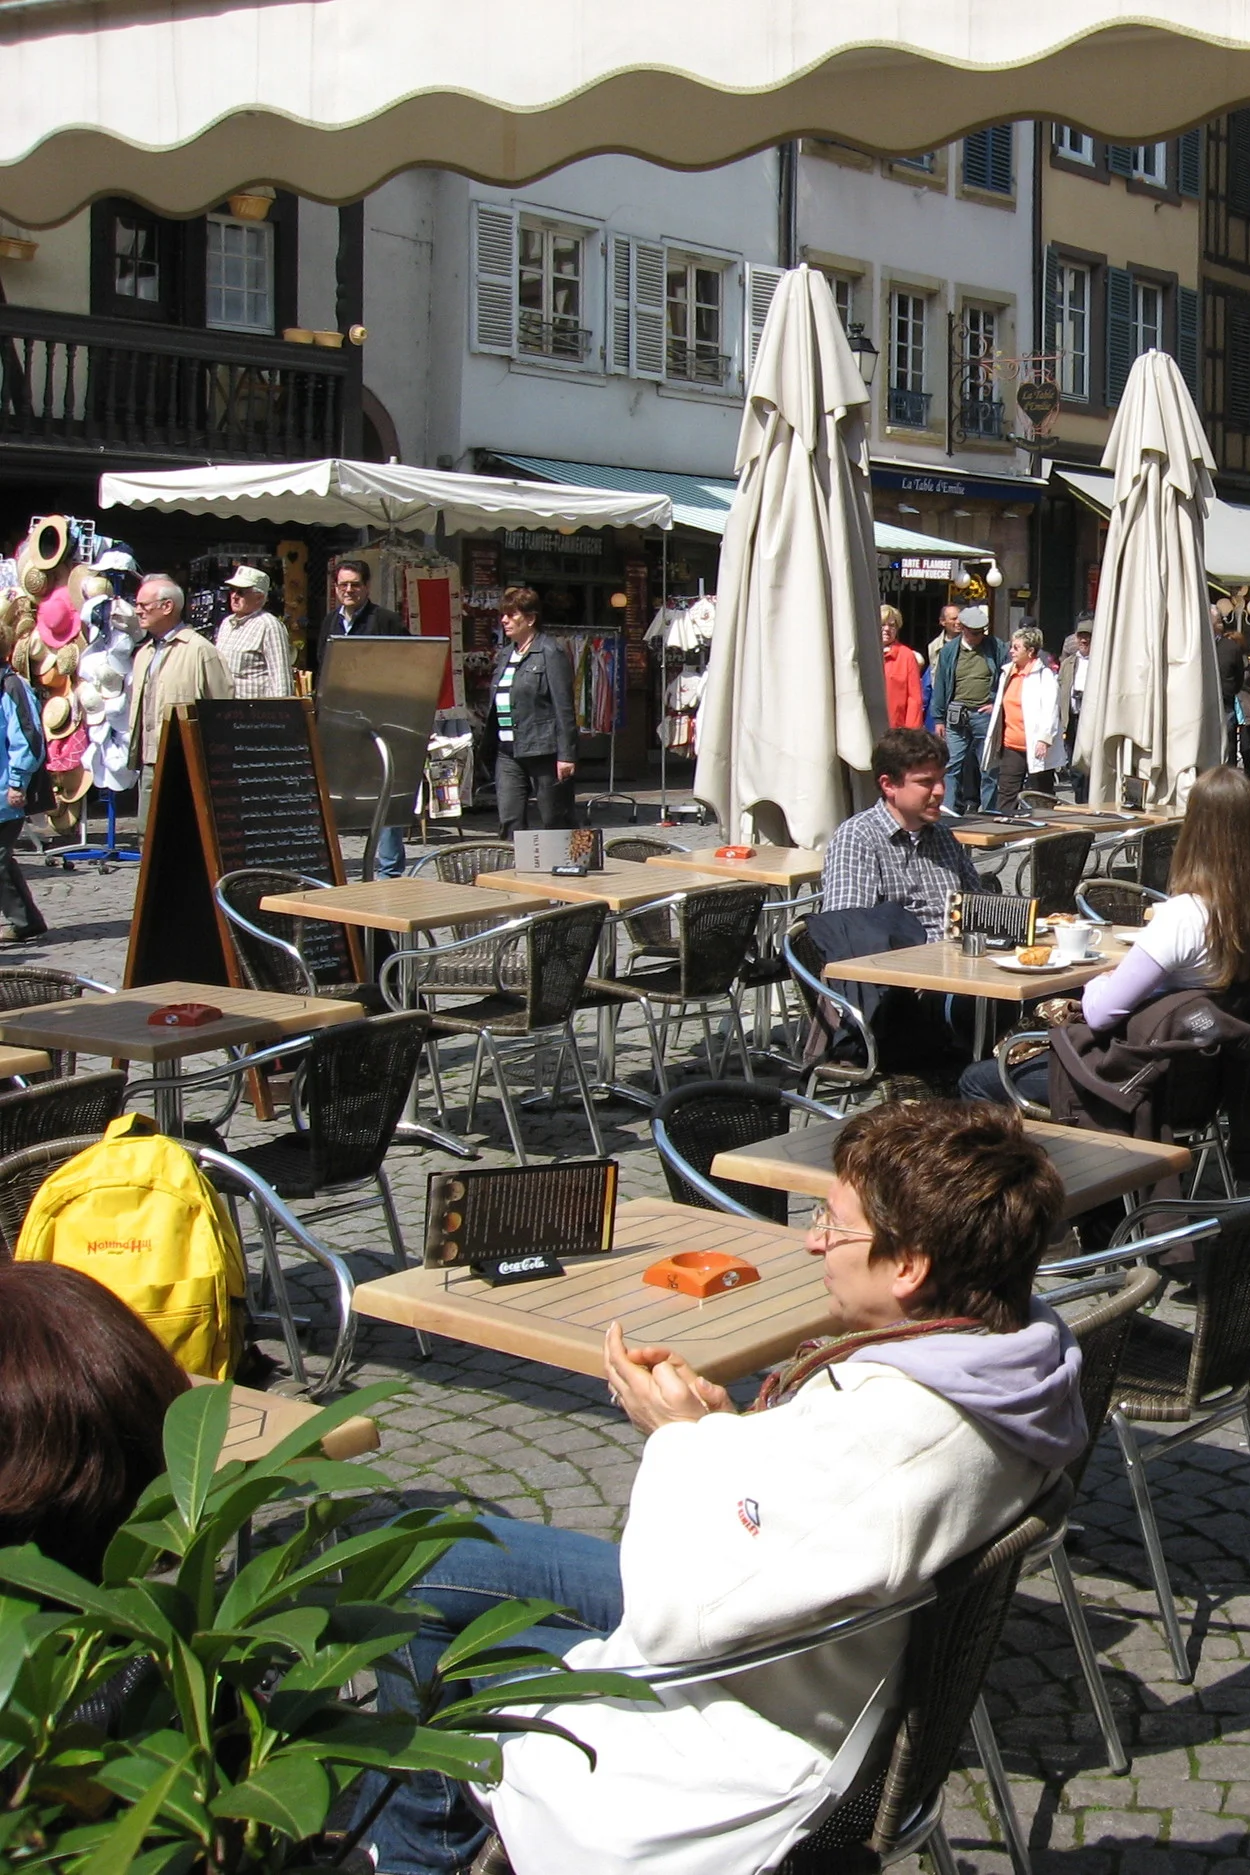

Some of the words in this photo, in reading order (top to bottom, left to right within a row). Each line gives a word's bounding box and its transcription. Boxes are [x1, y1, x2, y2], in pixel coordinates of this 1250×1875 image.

[901, 477, 913, 490] La
[915, 478, 934, 492] Table
[87, 1240, 130, 1256] Notting
[130, 1238, 152, 1253] Hill
